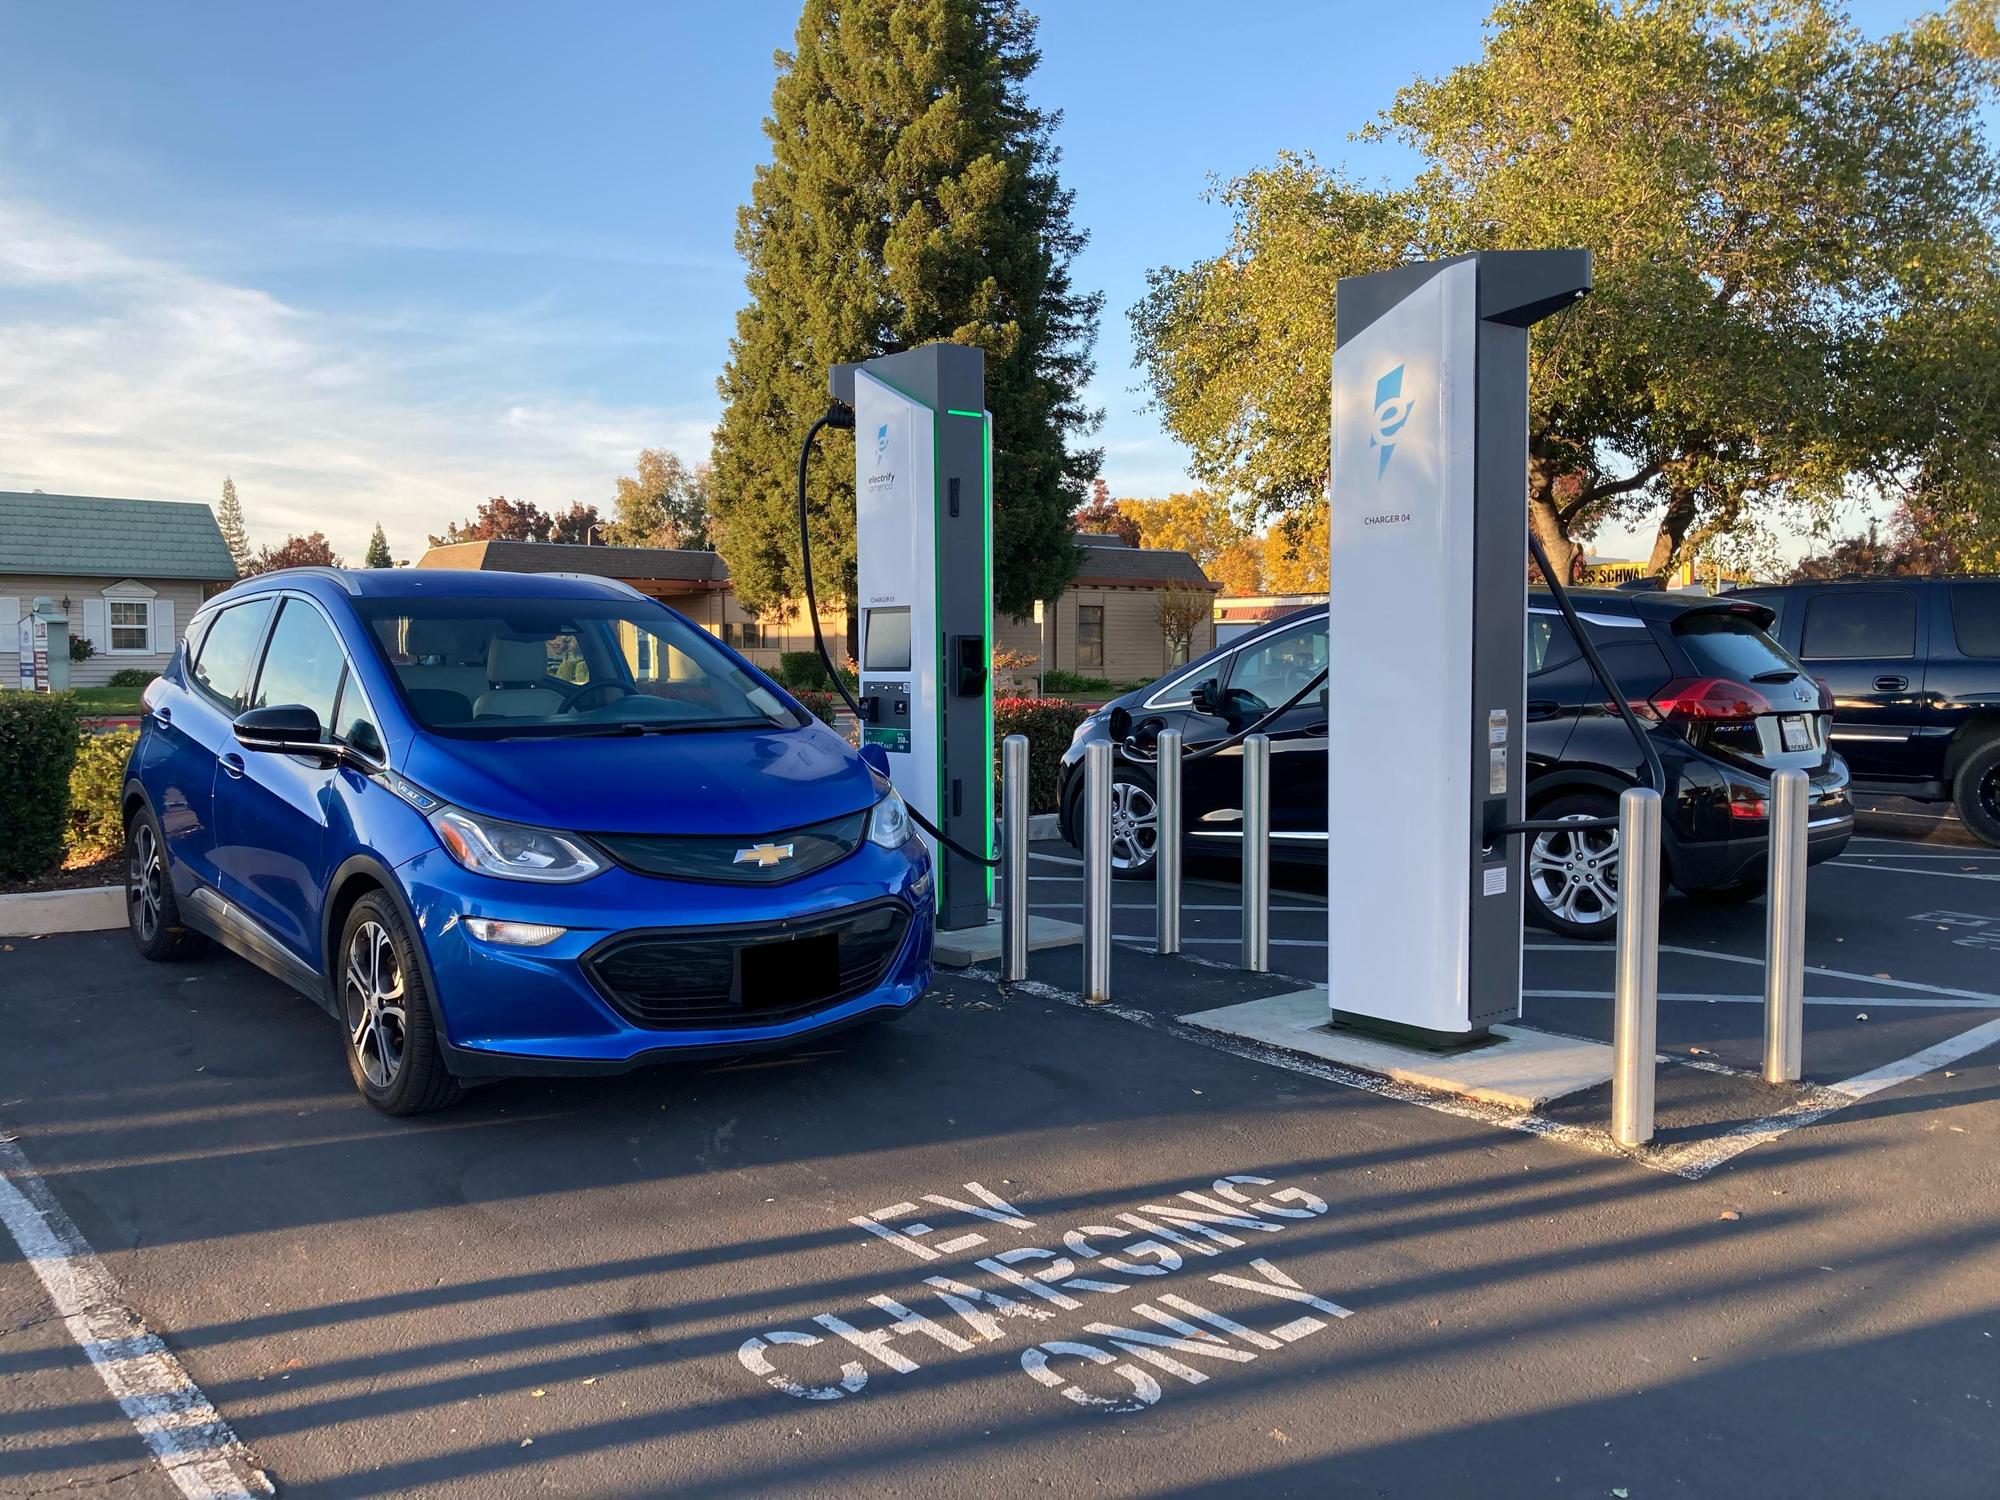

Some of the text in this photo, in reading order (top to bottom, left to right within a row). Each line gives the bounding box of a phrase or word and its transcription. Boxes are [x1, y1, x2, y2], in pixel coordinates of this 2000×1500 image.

[868, 472, 896, 484] electrify
[1364, 514, 1410, 525] CHARGER 04
[848, 1181, 1037, 1261] EV
[737, 1175, 1328, 1400] CHARGING
[1020, 1257, 1355, 1413] ONLY
